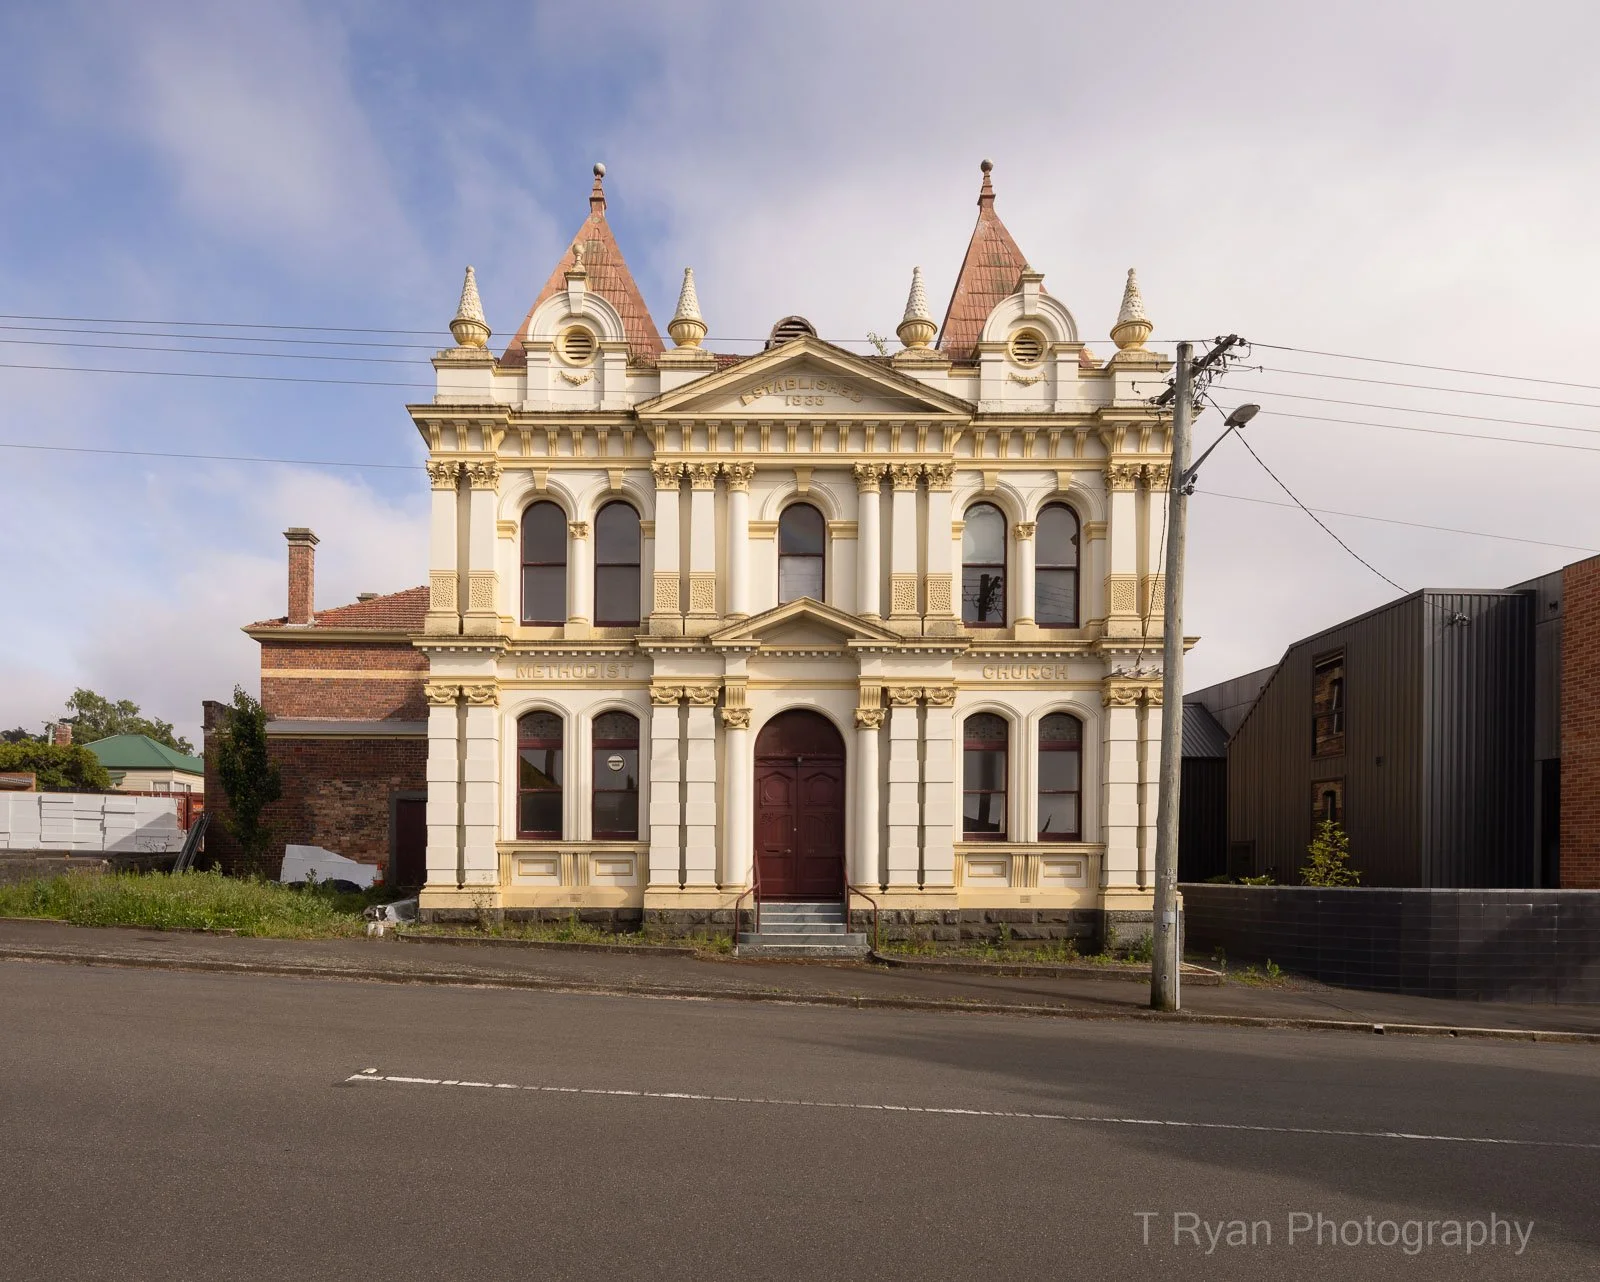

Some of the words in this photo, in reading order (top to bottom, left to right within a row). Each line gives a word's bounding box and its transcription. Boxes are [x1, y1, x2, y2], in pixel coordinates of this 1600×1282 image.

[739, 377, 864, 406] ESTABLISHED
[516, 663, 633, 678] METHODIST
[983, 664, 1068, 679] CHURCH
